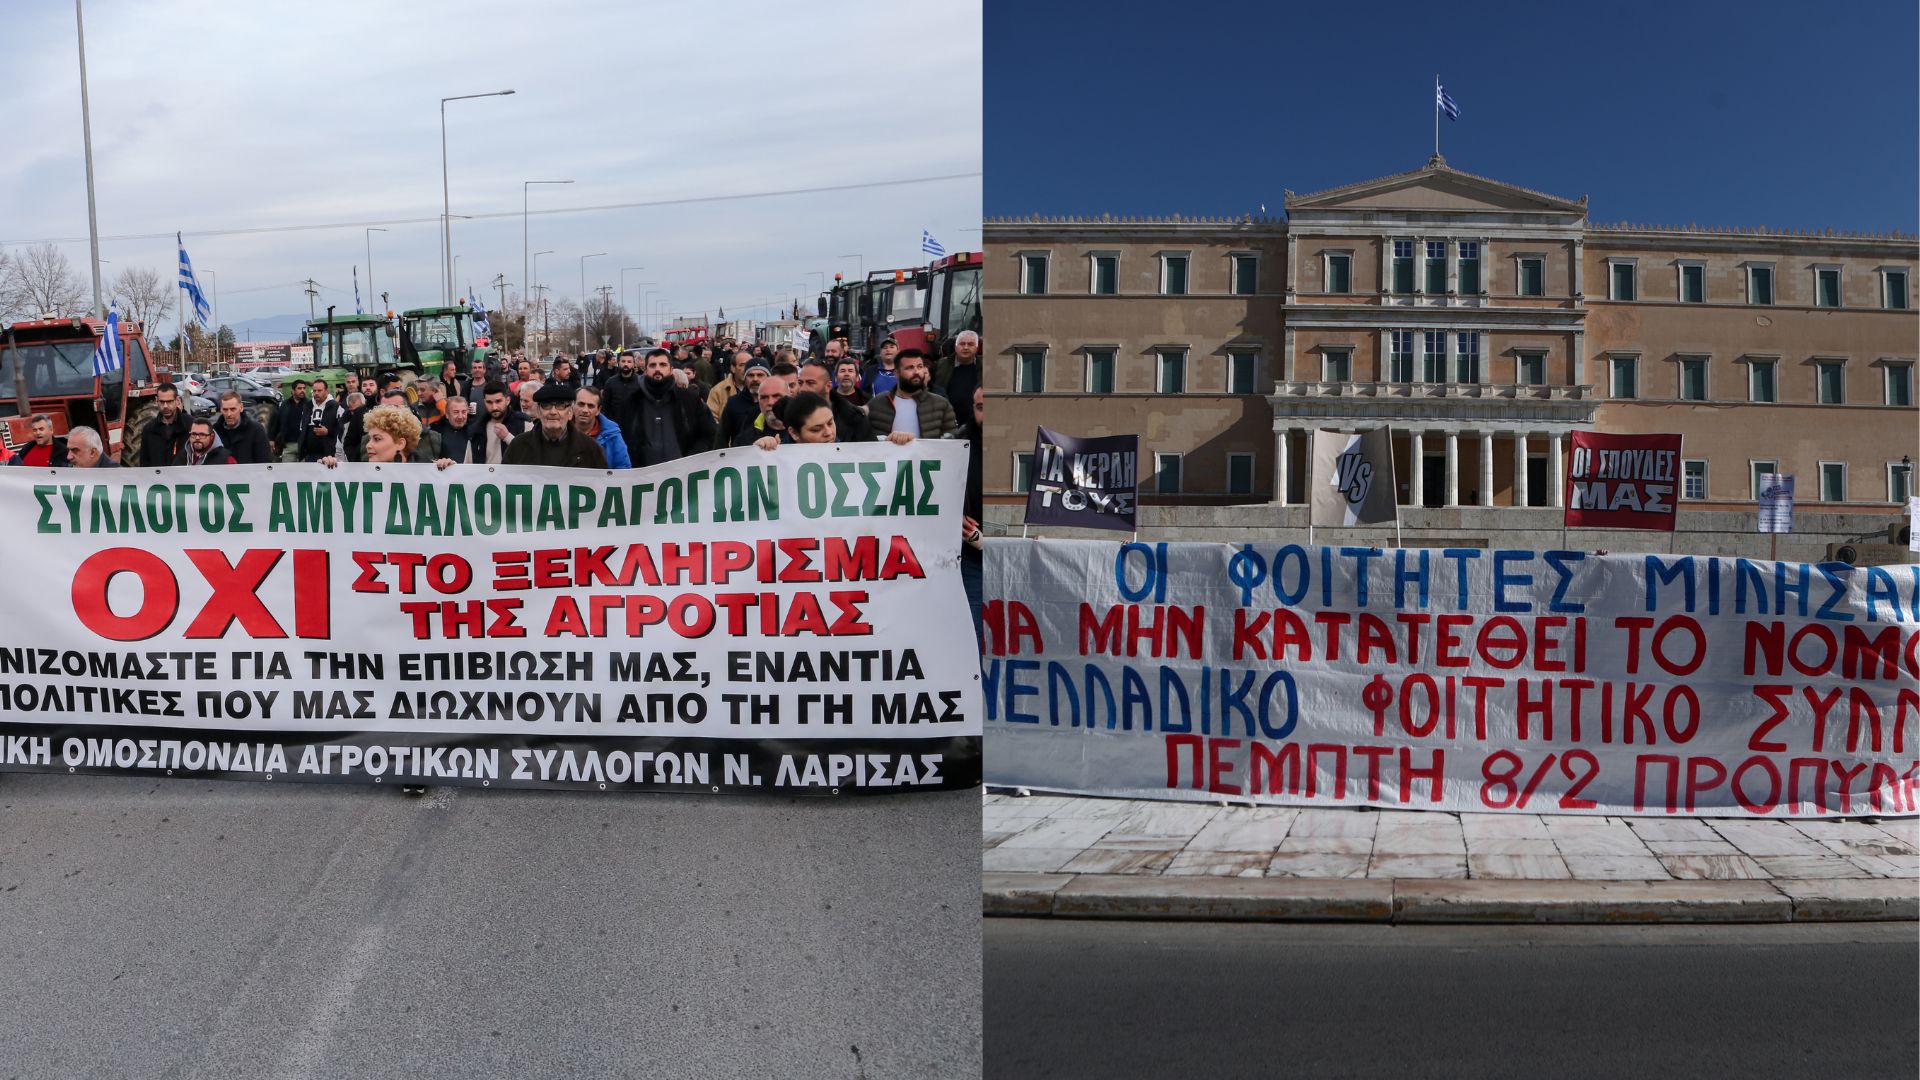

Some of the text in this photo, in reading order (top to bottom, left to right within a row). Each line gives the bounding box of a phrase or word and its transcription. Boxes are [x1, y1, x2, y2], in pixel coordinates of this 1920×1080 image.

[1040, 443, 1064, 482] ΤΑ
[1338, 453, 1372, 503] VS
[1572, 447, 1675, 481] ΟΙ ΣΠΟΥΔΕΣ
[33, 459, 942, 536] ΣΥΛΛΟΓΟΣ ΑΜΥΓΔΑΛΟΠΑΡΑΓΩΓΩΝ ΟΣΣΑΣ
[1035, 484, 1135, 514] ΤΟΥΣ
[1570, 481, 1673, 513] ΜΑΣ
[351, 535, 926, 594] ΣΤΟ ΞΕΚΛΗΡΙΣΜΑ
[1115, 542, 1919, 622] ΟΙ ΦΟΙΤΗΤΕΣ ΜΙΛΗΣΑ
[71, 546, 331, 641] ΟΧΙ
[400, 589, 874, 640] ΤΗΣ ΑΓΡΟΤΙΑΣ
[1078, 602, 1205, 660] ΜΗΝ
[1233, 607, 1586, 673] ΚΑΤΑΤΕΘΕΙ
[1615, 614, 1707, 676] ΤΟ
[0, 647, 925, 688] ΝΙΖΟΜΑΣΤΕ ΓΙΑ ΤΗΝ ΕΠΙΒΙΩΣΗ ΜΑΣ, ΕΝΑΝΤΙΑ
[197, 689, 275, 720] ΠΟΥ
[293, 690, 376, 720] ΜΑΣ
[388, 690, 602, 723] ΔΙΩΧΝΟΥΝ
[616, 692, 708, 724] ΑΠΟ
[721, 693, 780, 725] ΤΗ
[798, 693, 853, 725] ΓΗ
[871, 690, 965, 725] ΜΑΣ
[1362, 673, 1701, 745] ΦΟΙΤΗΤΙΚΟ
[62, 736, 289, 775] ΟΜΟΣΠΟΝΔΙΑ
[298, 744, 499, 779] ΑΓΡΟΤΙΚΩΝ
[511, 748, 709, 785] ΣΥΛΛΟΓΩΝ
[723, 753, 762, 786] Ν.
[773, 753, 944, 788] ΛΑΡΙΣΑΣ
[1165, 733, 1445, 803] ΠΕΜΠΤΗ
[1480, 748, 1600, 810] 8/2
